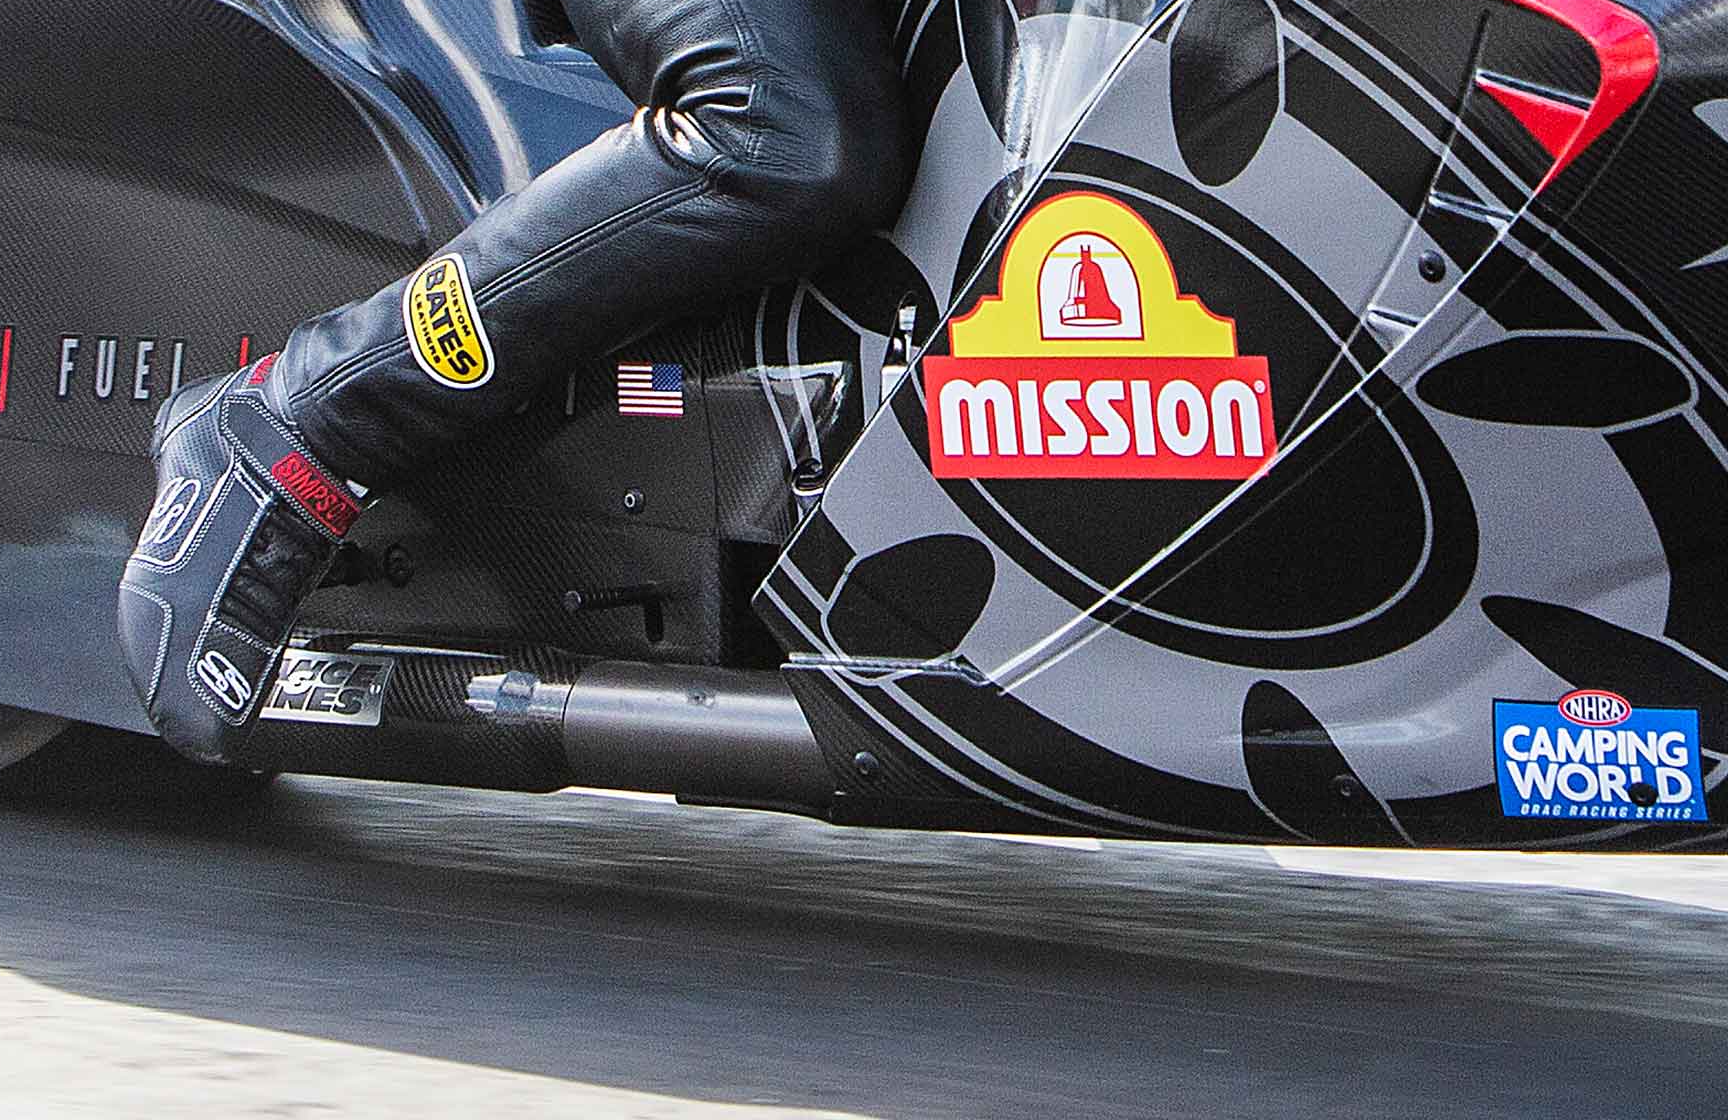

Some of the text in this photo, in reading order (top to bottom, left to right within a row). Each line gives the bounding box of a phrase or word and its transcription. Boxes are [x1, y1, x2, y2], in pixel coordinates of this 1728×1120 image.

[414, 293, 442, 364] LEATHERS
[425, 263, 478, 376] BATES
[448, 279, 472, 337] CUSTOM
[937, 377, 1267, 458] MISSION
[278, 657, 383, 688] NCE
[1569, 697, 1622, 721] NHRA
[1502, 724, 1689, 768] CAMPING
[1520, 803, 1693, 819] DRAG RACING SERIES
